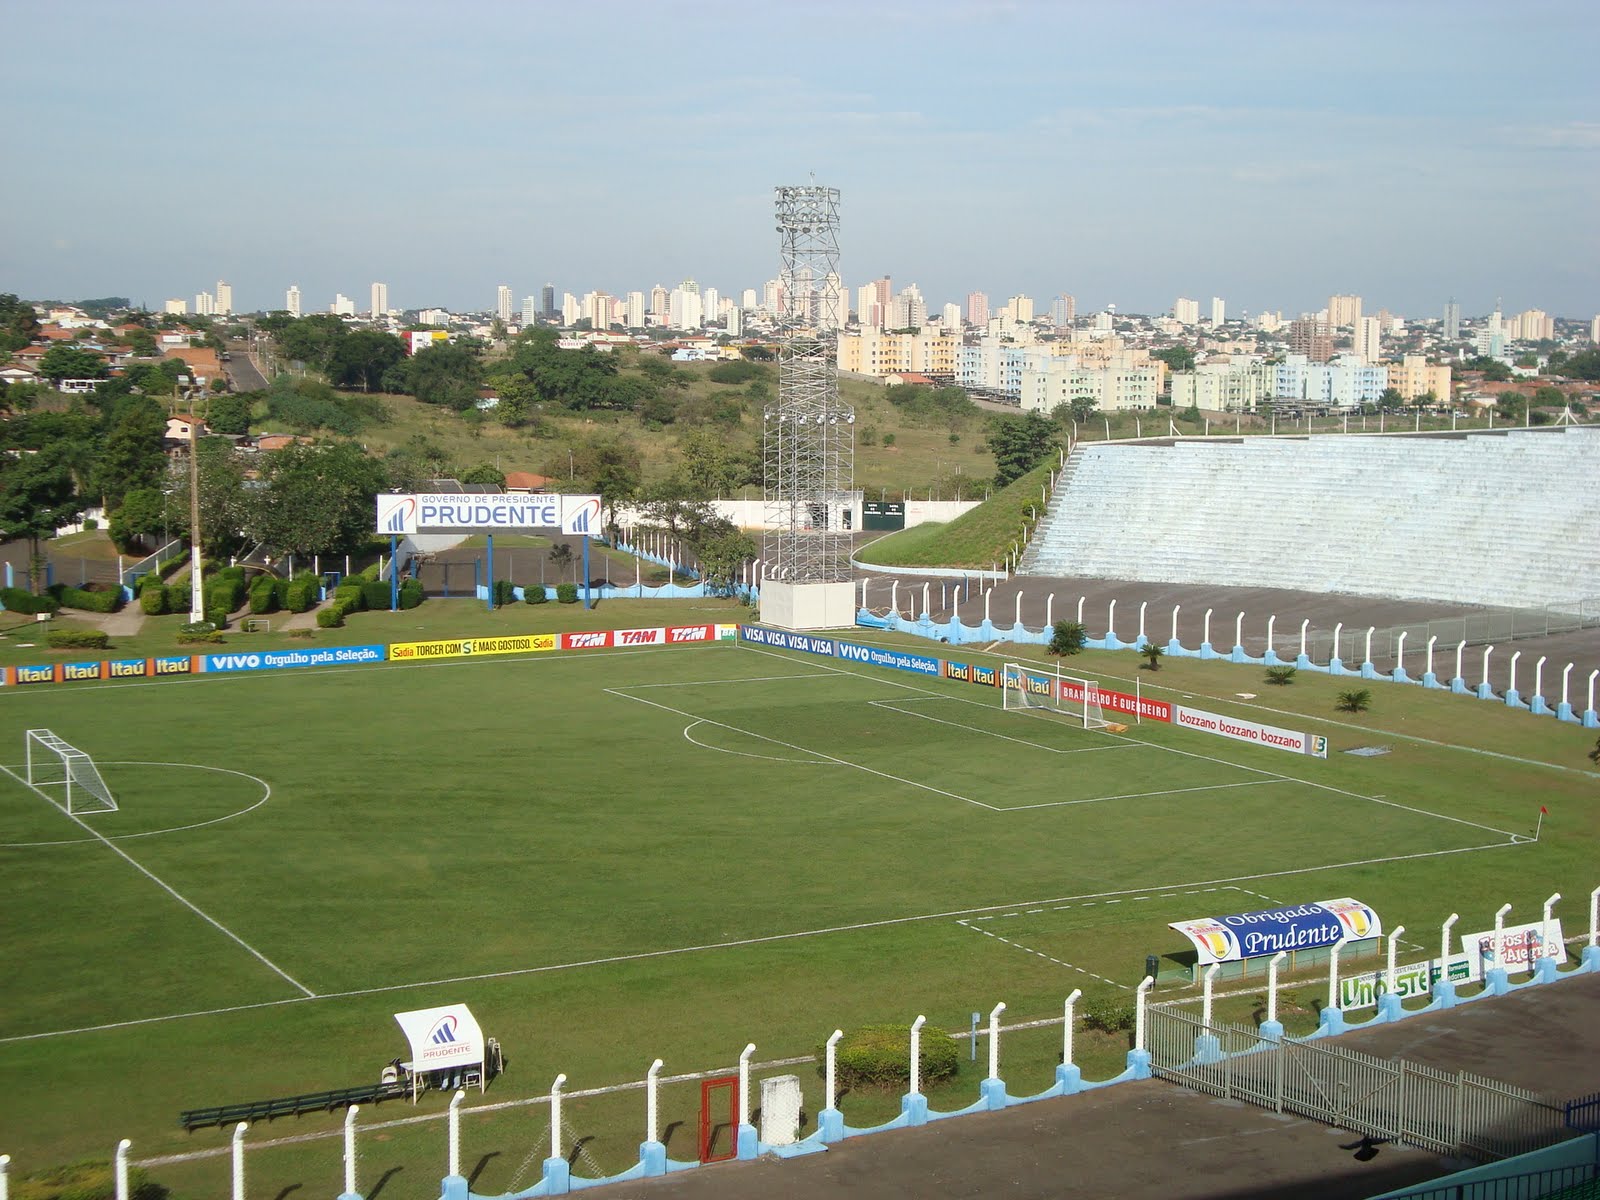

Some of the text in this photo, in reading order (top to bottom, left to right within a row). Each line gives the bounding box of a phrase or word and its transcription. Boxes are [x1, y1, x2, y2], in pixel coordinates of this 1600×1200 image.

[421, 495, 556, 504] GOVERNO DE PRESIDENTE
[421, 505, 556, 524] PRUDENTE
[568, 633, 607, 647] TAM
[621, 630, 657, 644] TAM
[671, 626, 707, 641] TAM
[720, 628, 735, 637] BR
[744, 628, 832, 655] VISA VISA VISA VISA
[392, 646, 413, 658] Sadia
[416, 645, 444, 656] TORCER
[445, 643, 462, 655] COM
[473, 640, 477, 652] É
[479, 641, 497, 652] MAIS
[533, 638, 554, 648] Sadia
[840, 644, 869, 661] VIVO
[871, 651, 896, 664] Orgulho
[897, 656, 911, 668] pela
[212, 648, 378, 669] VIVO Orgulho pela Seleção.
[18, 666, 52, 682] Itaú
[65, 664, 99, 679] Itaú
[111, 661, 144, 677] Itaú
[156, 658, 190, 673] Itaú
[947, 663, 1049, 695] Itaú Itaú Iaú Itaú
[1113, 694, 1118, 707] É
[1180, 710, 1302, 749] bozzano bozzano bozzano
[1225, 904, 1322, 926] Obrigado
[1245, 923, 1339, 953] Prudente
[423, 1045, 471, 1059] PRUDENTE
